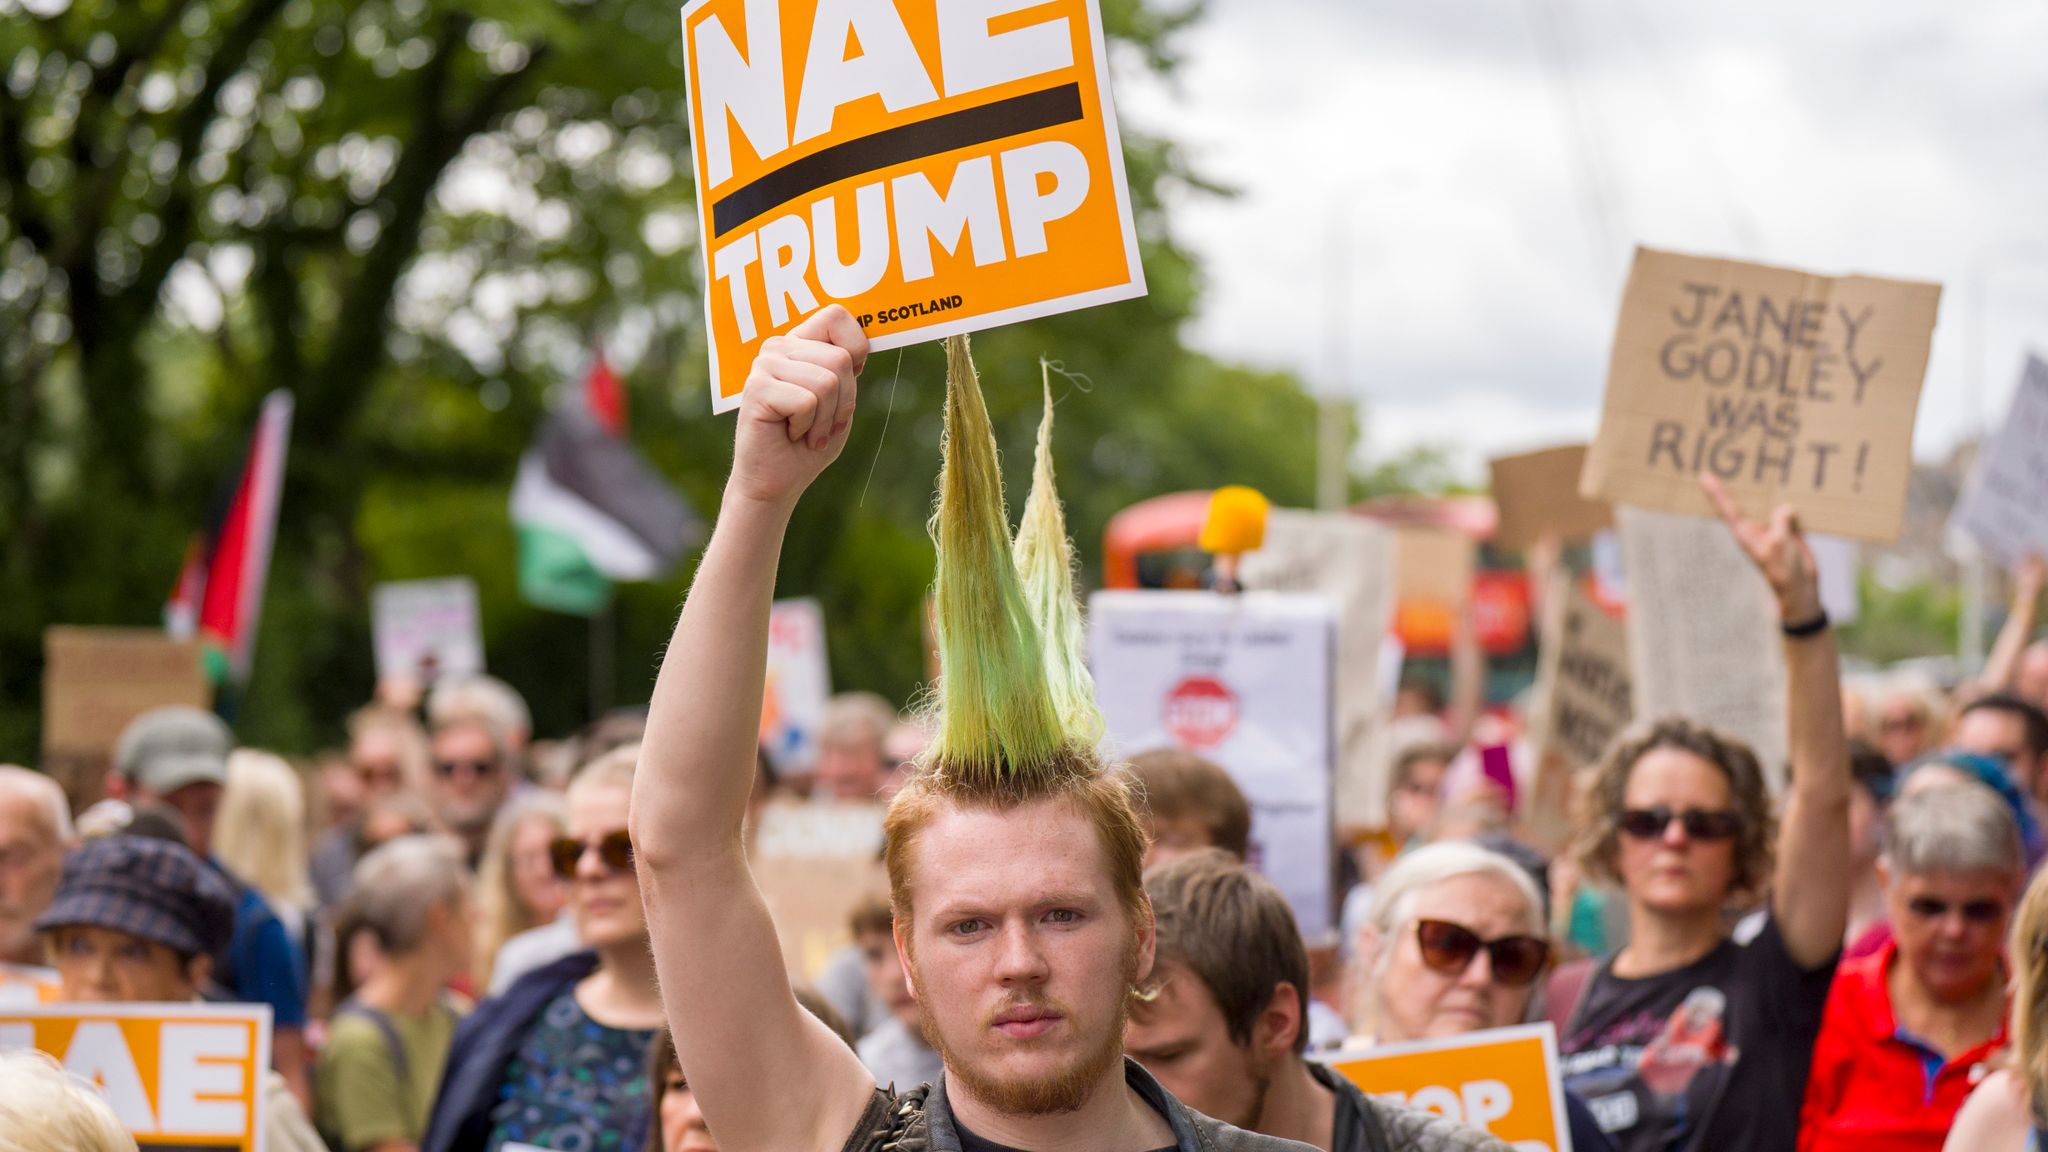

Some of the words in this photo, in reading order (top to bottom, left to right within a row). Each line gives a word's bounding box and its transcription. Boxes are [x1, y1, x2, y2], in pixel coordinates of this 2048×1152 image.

[694, 0, 1074, 190] NAE
[714, 141, 1090, 344] TRUMP
[877, 295, 963, 324] SCOTLAND
[1671, 281, 1875, 352] JANEY
[1660, 333, 1883, 406] GODLEY
[1706, 394, 1802, 440] WAS
